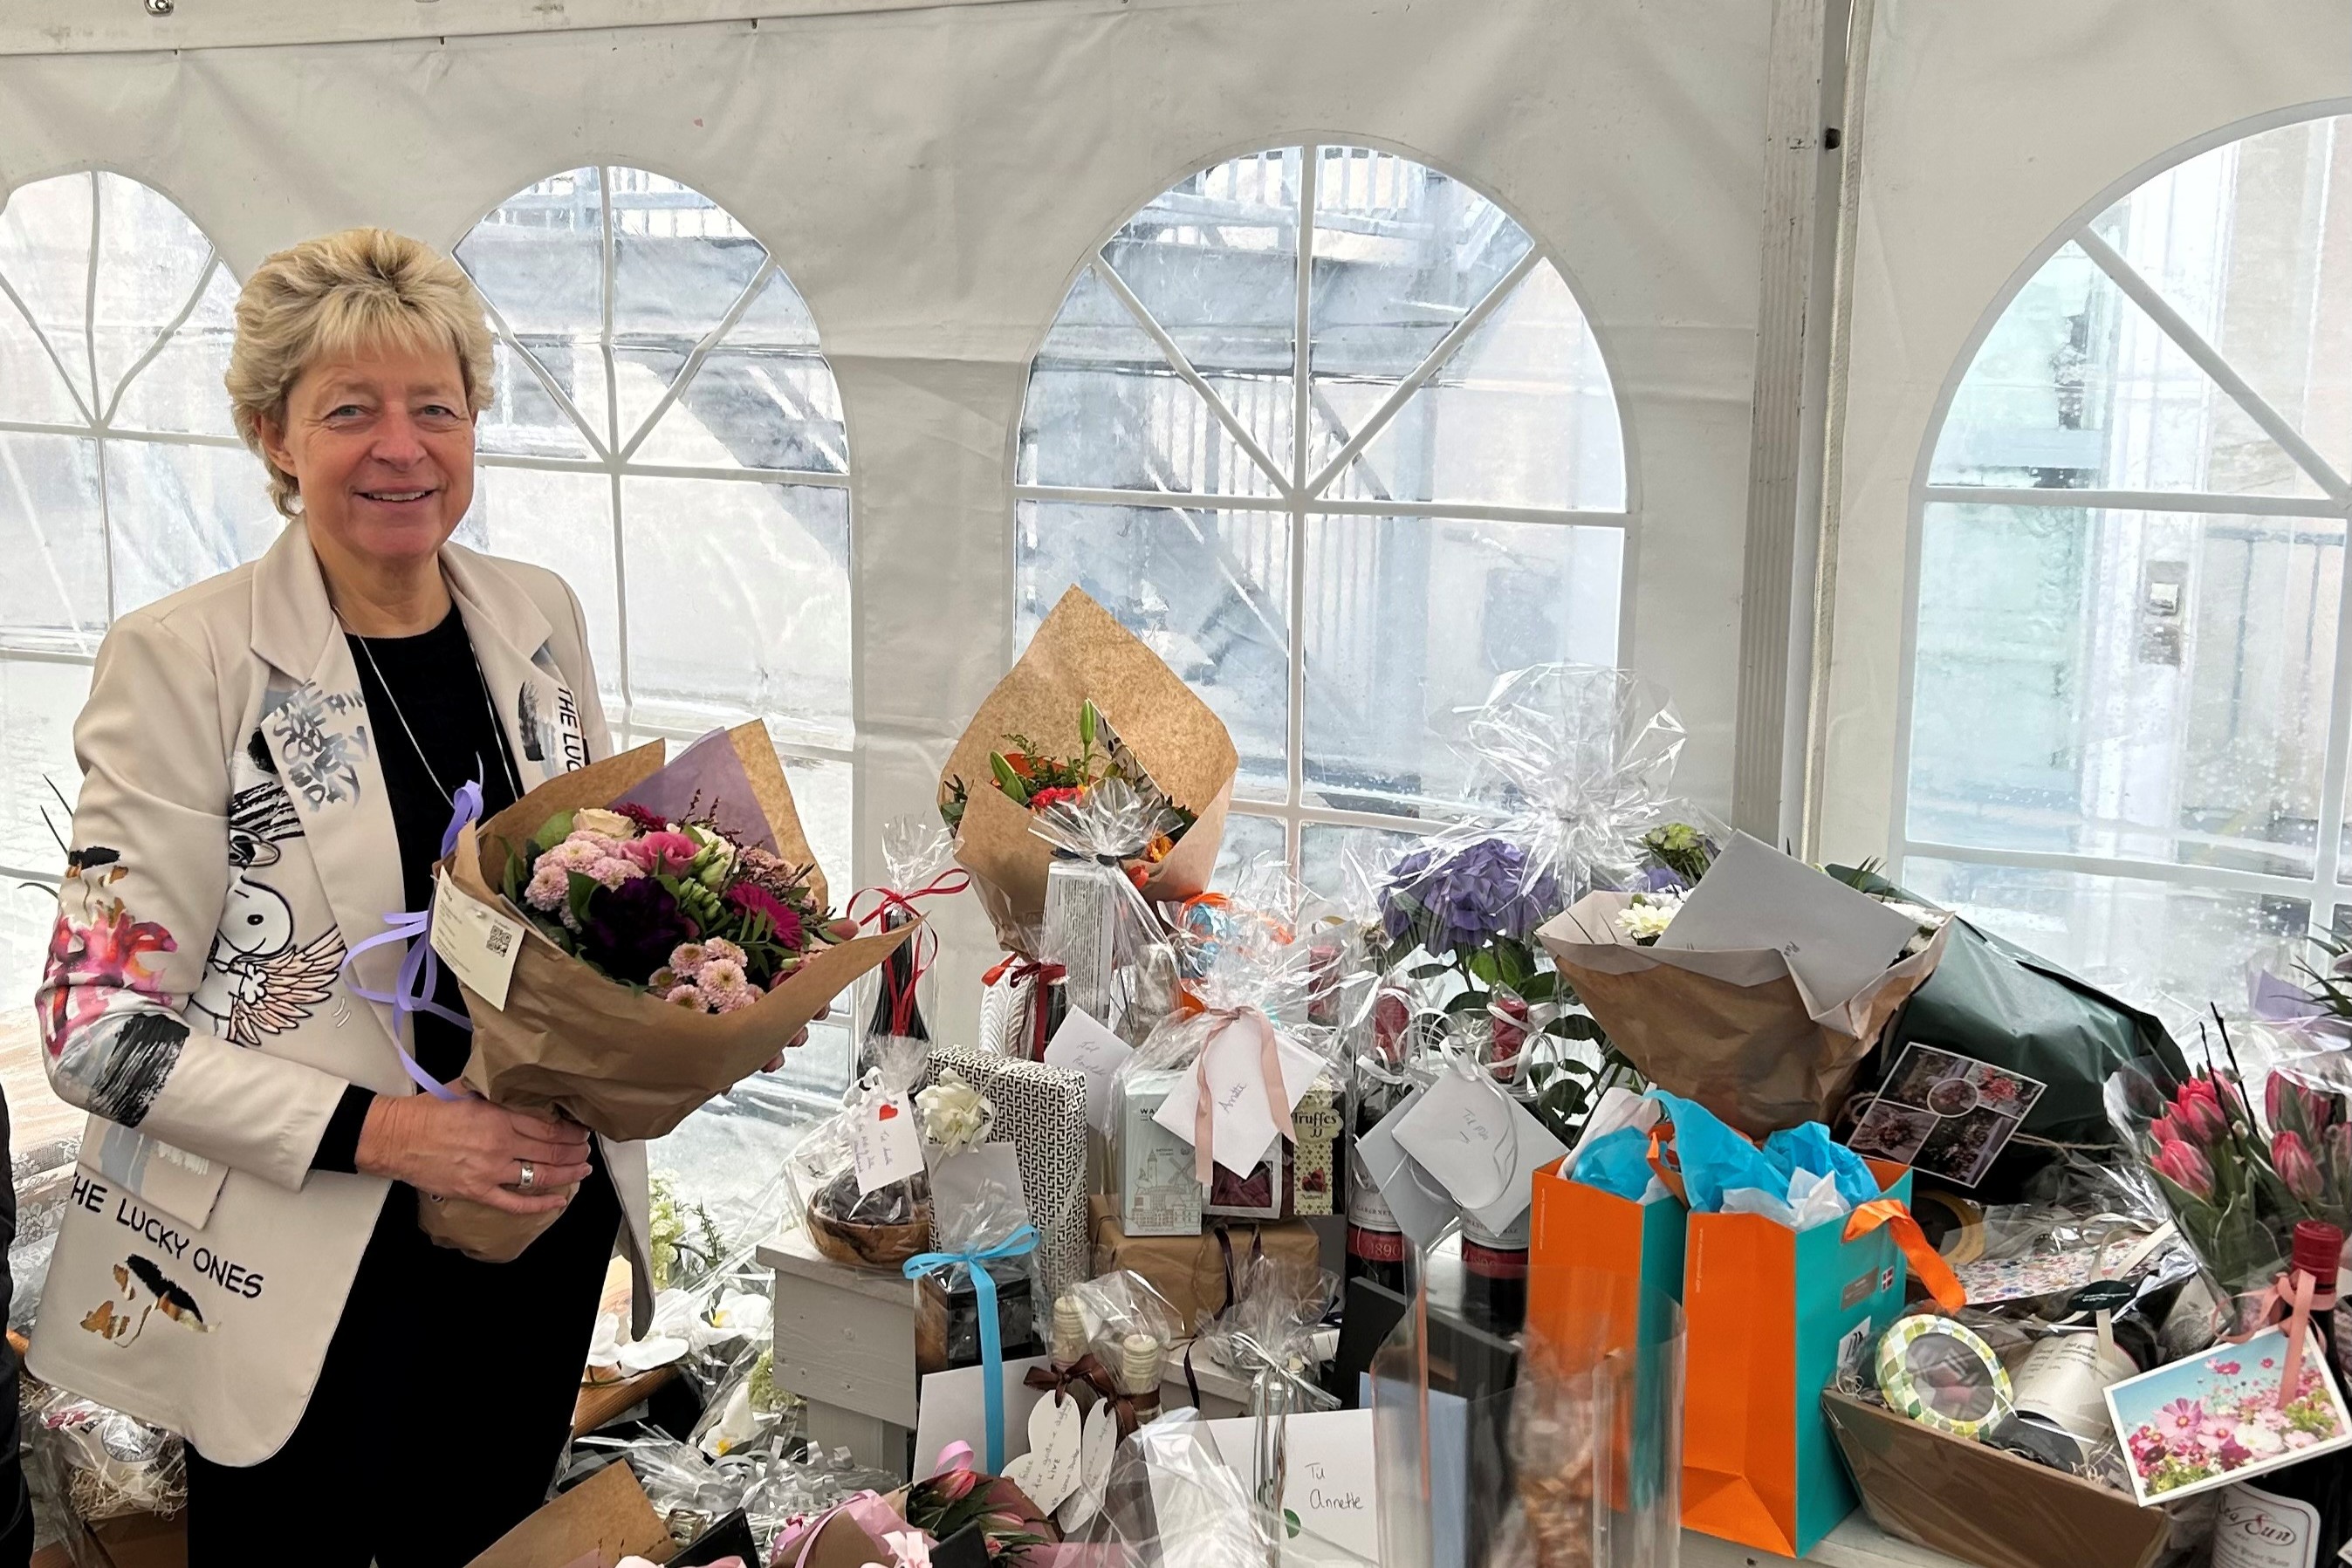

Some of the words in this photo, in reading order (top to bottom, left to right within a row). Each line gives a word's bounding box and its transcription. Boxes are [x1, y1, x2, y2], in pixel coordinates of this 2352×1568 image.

[558, 687, 578, 729] THE
[563, 732, 582, 772] LUC
[71, 1171, 108, 1214] HE
[116, 1197, 190, 1259] LUCKY
[193, 1247, 264, 1299] ONES
[1309, 1488, 1364, 1510] Annette
[2245, 1514, 2291, 1542] Sun
